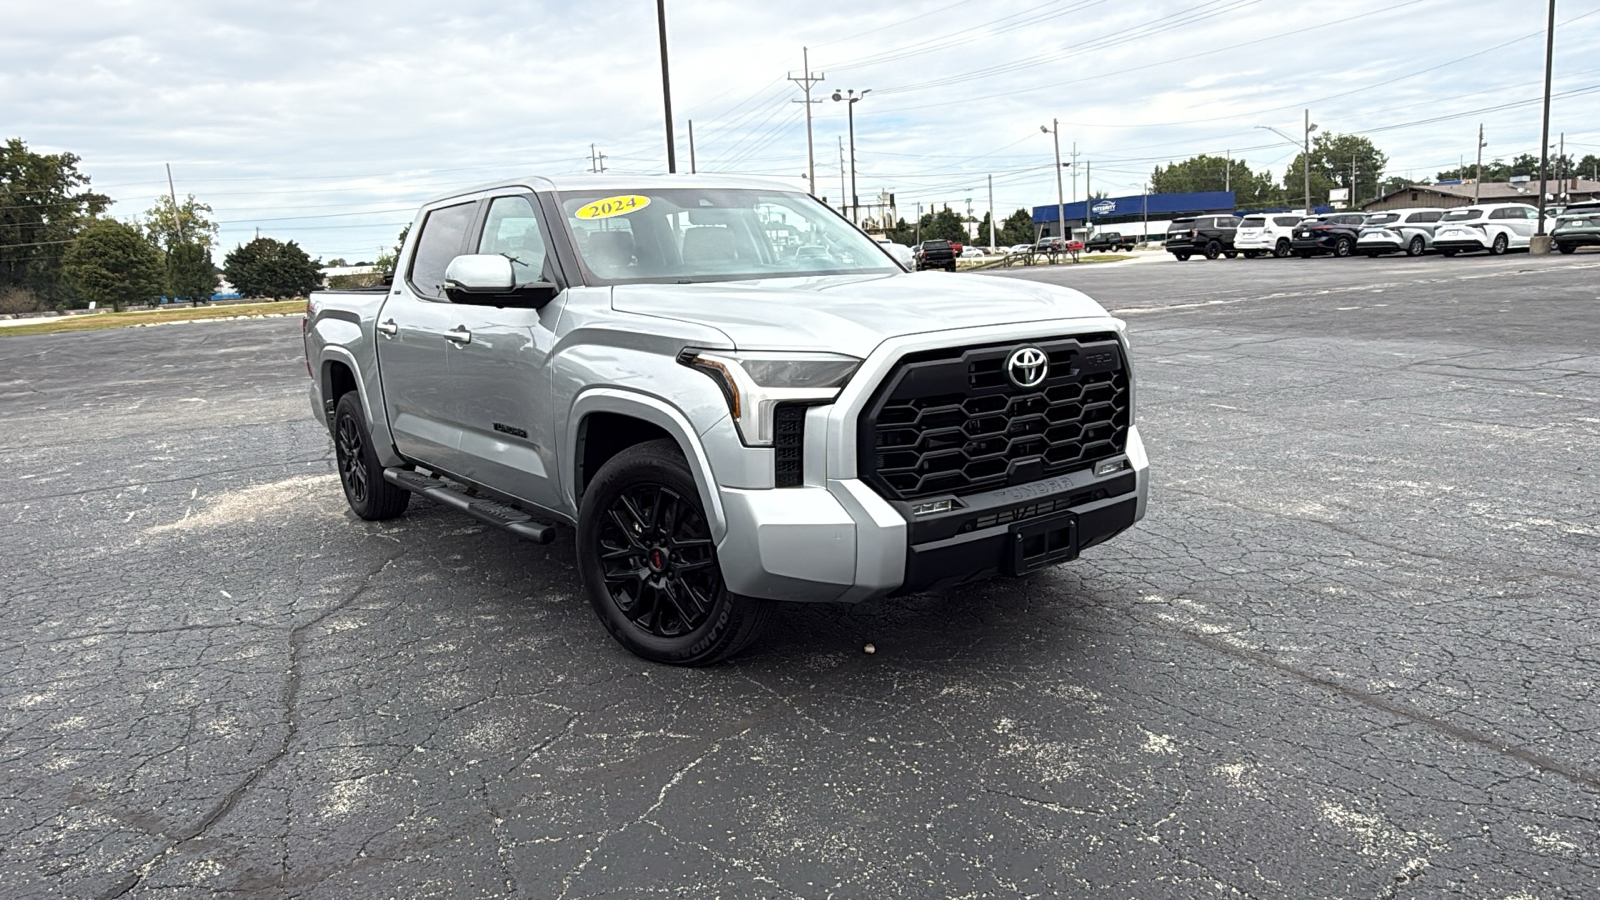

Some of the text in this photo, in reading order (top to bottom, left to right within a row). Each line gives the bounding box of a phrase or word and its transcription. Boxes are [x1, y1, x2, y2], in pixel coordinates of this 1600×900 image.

[588, 197, 637, 218] 2024
[492, 421, 529, 439] TUNDRA
[993, 476, 1074, 502] TUNDRA
